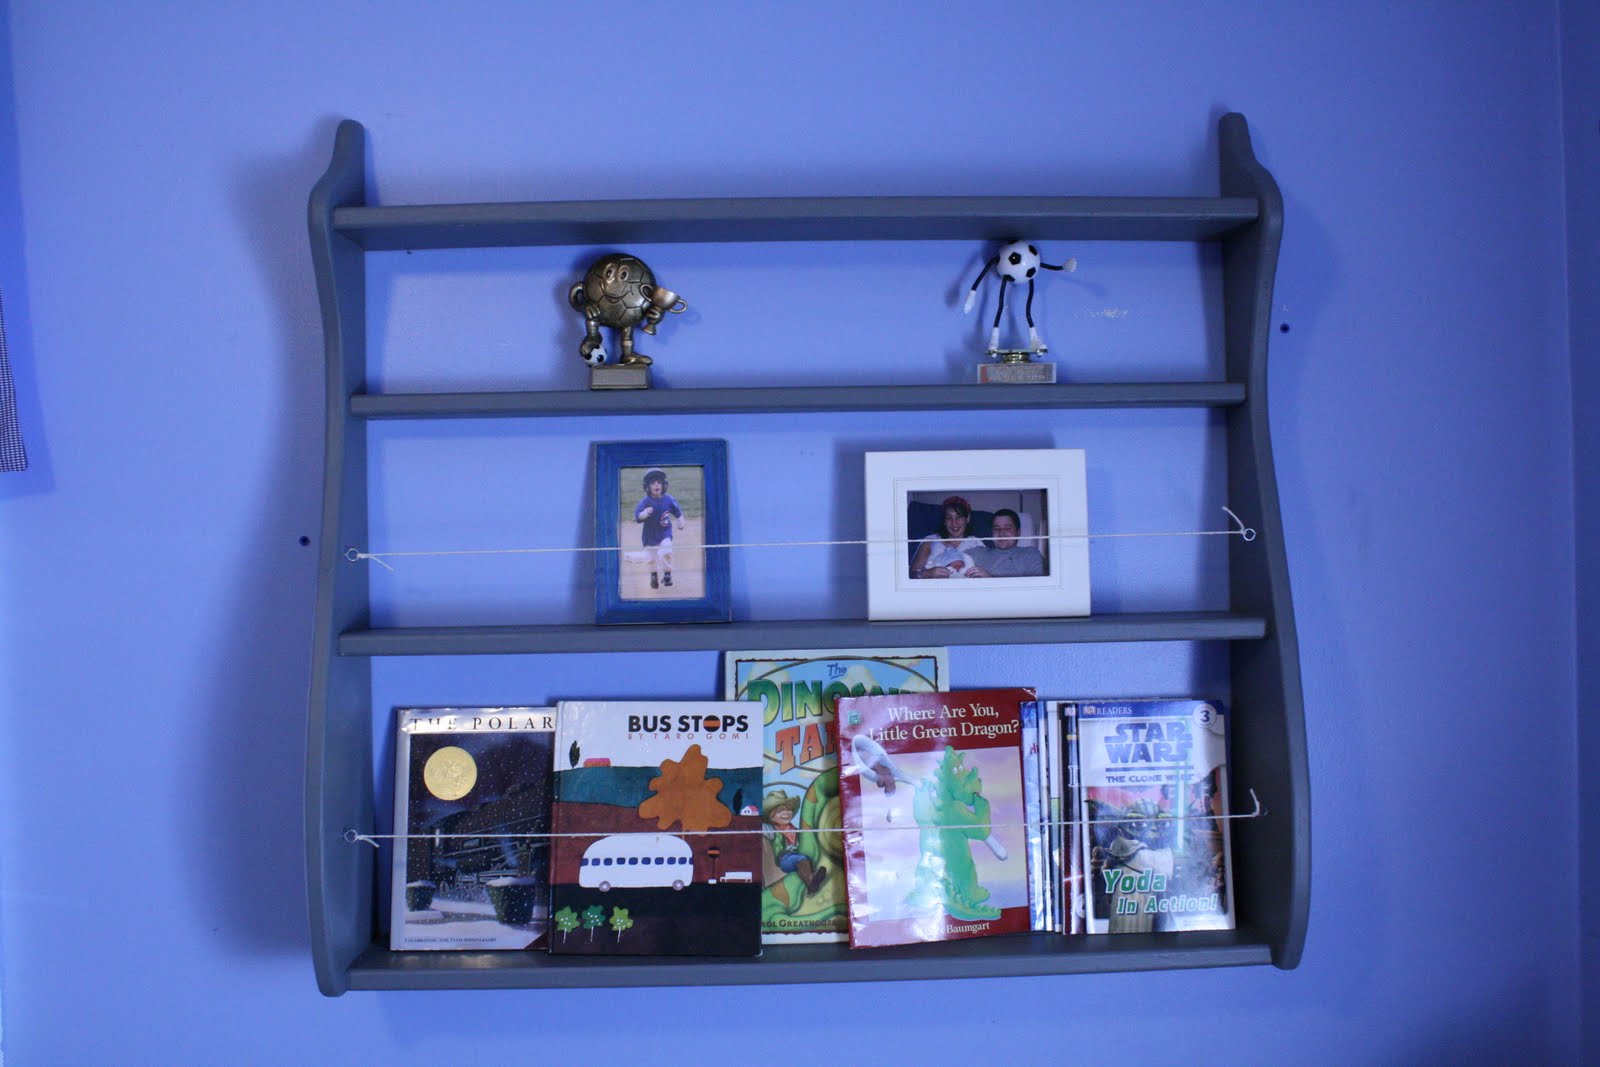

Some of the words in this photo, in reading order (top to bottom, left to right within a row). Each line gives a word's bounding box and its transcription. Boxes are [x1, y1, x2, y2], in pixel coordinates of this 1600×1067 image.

[827, 663, 847, 678] The
[747, 679, 919, 726] DINO
[1097, 706, 1133, 715] READERS
[887, 704, 936, 722] Where
[940, 705, 967, 719] Are
[969, 703, 1000, 718] You,
[1200, 710, 1210, 723] 3
[472, 716, 554, 730] POLAR
[628, 715, 672, 732] BUS
[677, 714, 749, 733] STOPS
[869, 724, 908, 742] Little
[911, 724, 958, 740] Green
[960, 719, 1020, 739] Dragon?
[1104, 721, 1193, 744] STAR
[627, 732, 643, 740] BY
[1104, 741, 1193, 764] WARS
[1105, 776, 1126, 784] THE
[1128, 775, 1163, 783] CLONE
[1104, 868, 1166, 893] Yoda
[1117, 897, 1137, 914] In
[1144, 894, 1218, 913] Action!
[945, 922, 990, 934] Baumgart
